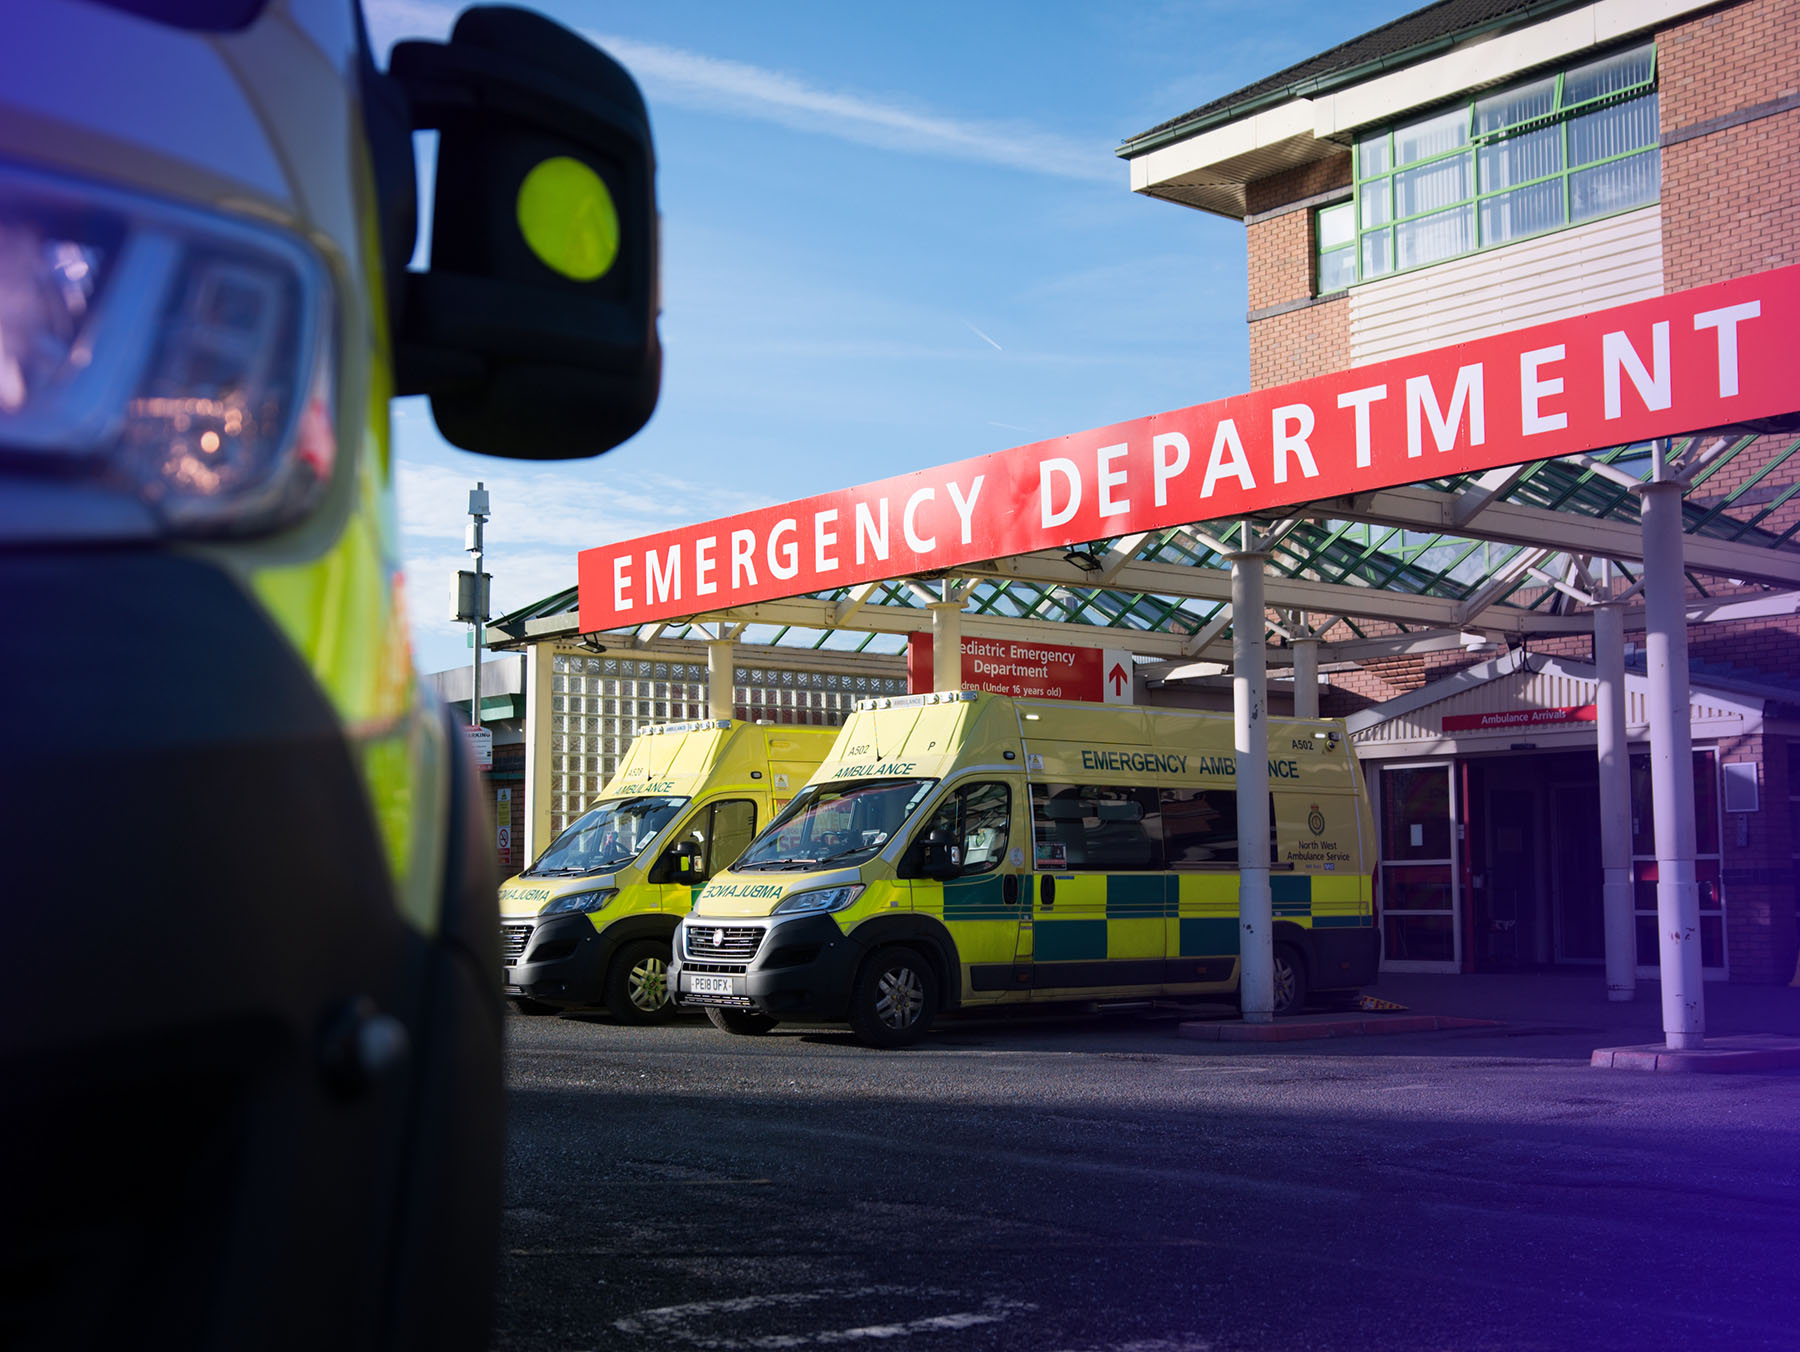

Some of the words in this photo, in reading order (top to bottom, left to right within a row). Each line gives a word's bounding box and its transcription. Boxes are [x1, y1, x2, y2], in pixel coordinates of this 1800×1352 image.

[612, 474, 986, 612] EMERGENCY
[1039, 299, 1761, 530] DEPARTMENT
[960, 640, 1006, 657] ediatric
[1010, 645, 1076, 667] Emergency
[973, 659, 1049, 678] Department
[961, 681, 980, 691] dren
[982, 681, 1010, 693] (Under
[1012, 684, 1021, 694] 16
[1023, 687, 1045, 697] years
[1046, 687, 1062, 698] old)
[1481, 713, 1529, 725] Ambulance
[1532, 709, 1567, 721] Arrivals
[848, 744, 870, 757] A502
[927, 741, 936, 751] P
[1292, 739, 1315, 751] A502
[831, 762, 917, 780] AMBULANCE
[1081, 750, 1188, 774] EMERGENCY
[1199, 755, 1301, 779] AMBNCE
[614, 781, 676, 796] AMBULANCE
[1298, 840, 1319, 850] North
[1321, 841, 1338, 851] West
[1287, 850, 1325, 861] Ambulance
[1326, 851, 1351, 862] Service
[695, 977, 712, 992] PE18
[712, 979, 728, 993] OFX
